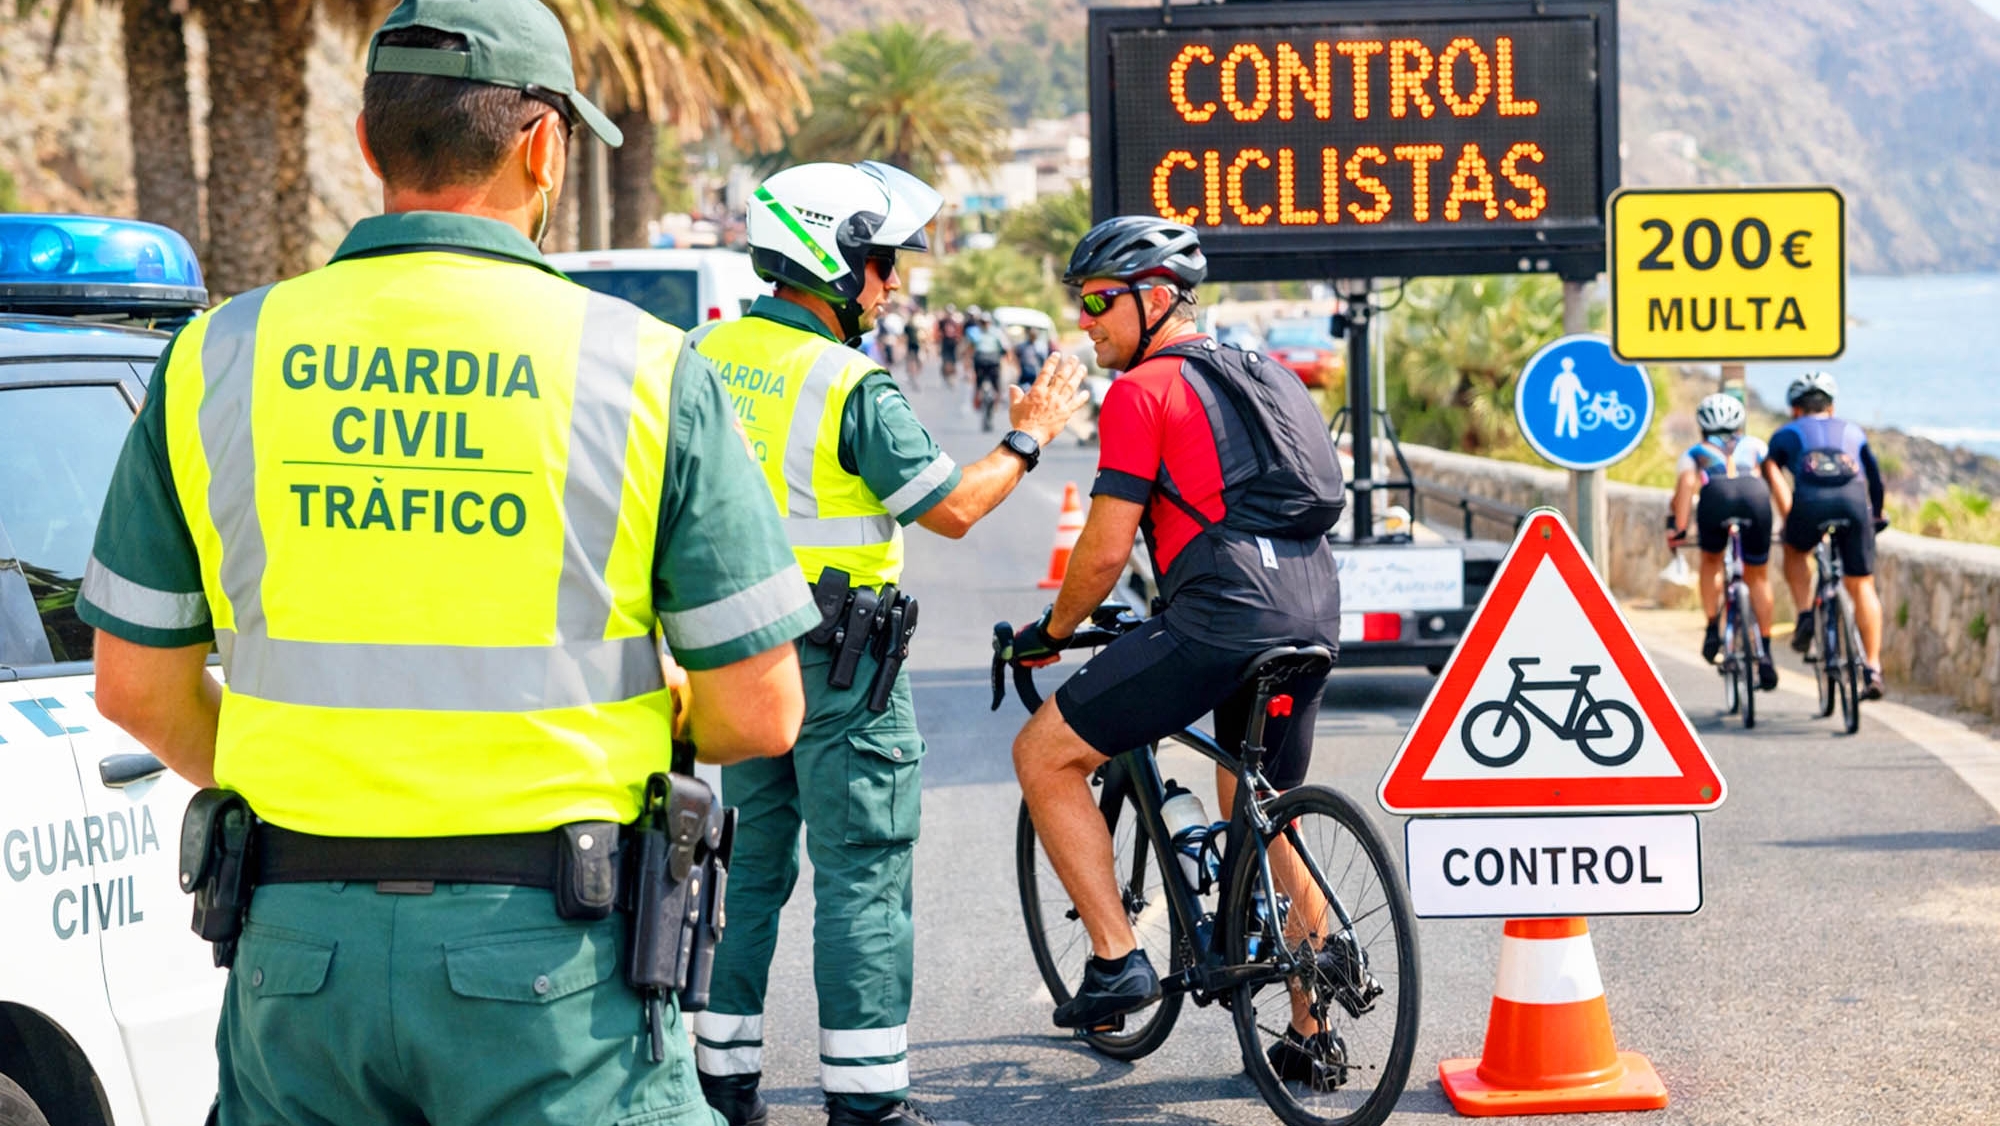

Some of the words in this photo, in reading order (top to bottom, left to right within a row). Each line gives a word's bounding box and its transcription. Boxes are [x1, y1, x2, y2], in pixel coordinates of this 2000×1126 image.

[1169, 36, 1539, 122] CONTROL
[1152, 142, 1547, 226] CICLISTAS
[1637, 216, 1813, 272] 200€
[1648, 296, 1807, 332] MULTA
[282, 343, 540, 399] GUARDIA
[714, 359, 785, 399] ARDIA
[332, 406, 484, 460] CIVIL
[3, 804, 160, 882] GUARDIA
[1442, 845, 1664, 887] CONTROL
[52, 875, 144, 941] CIVIL
